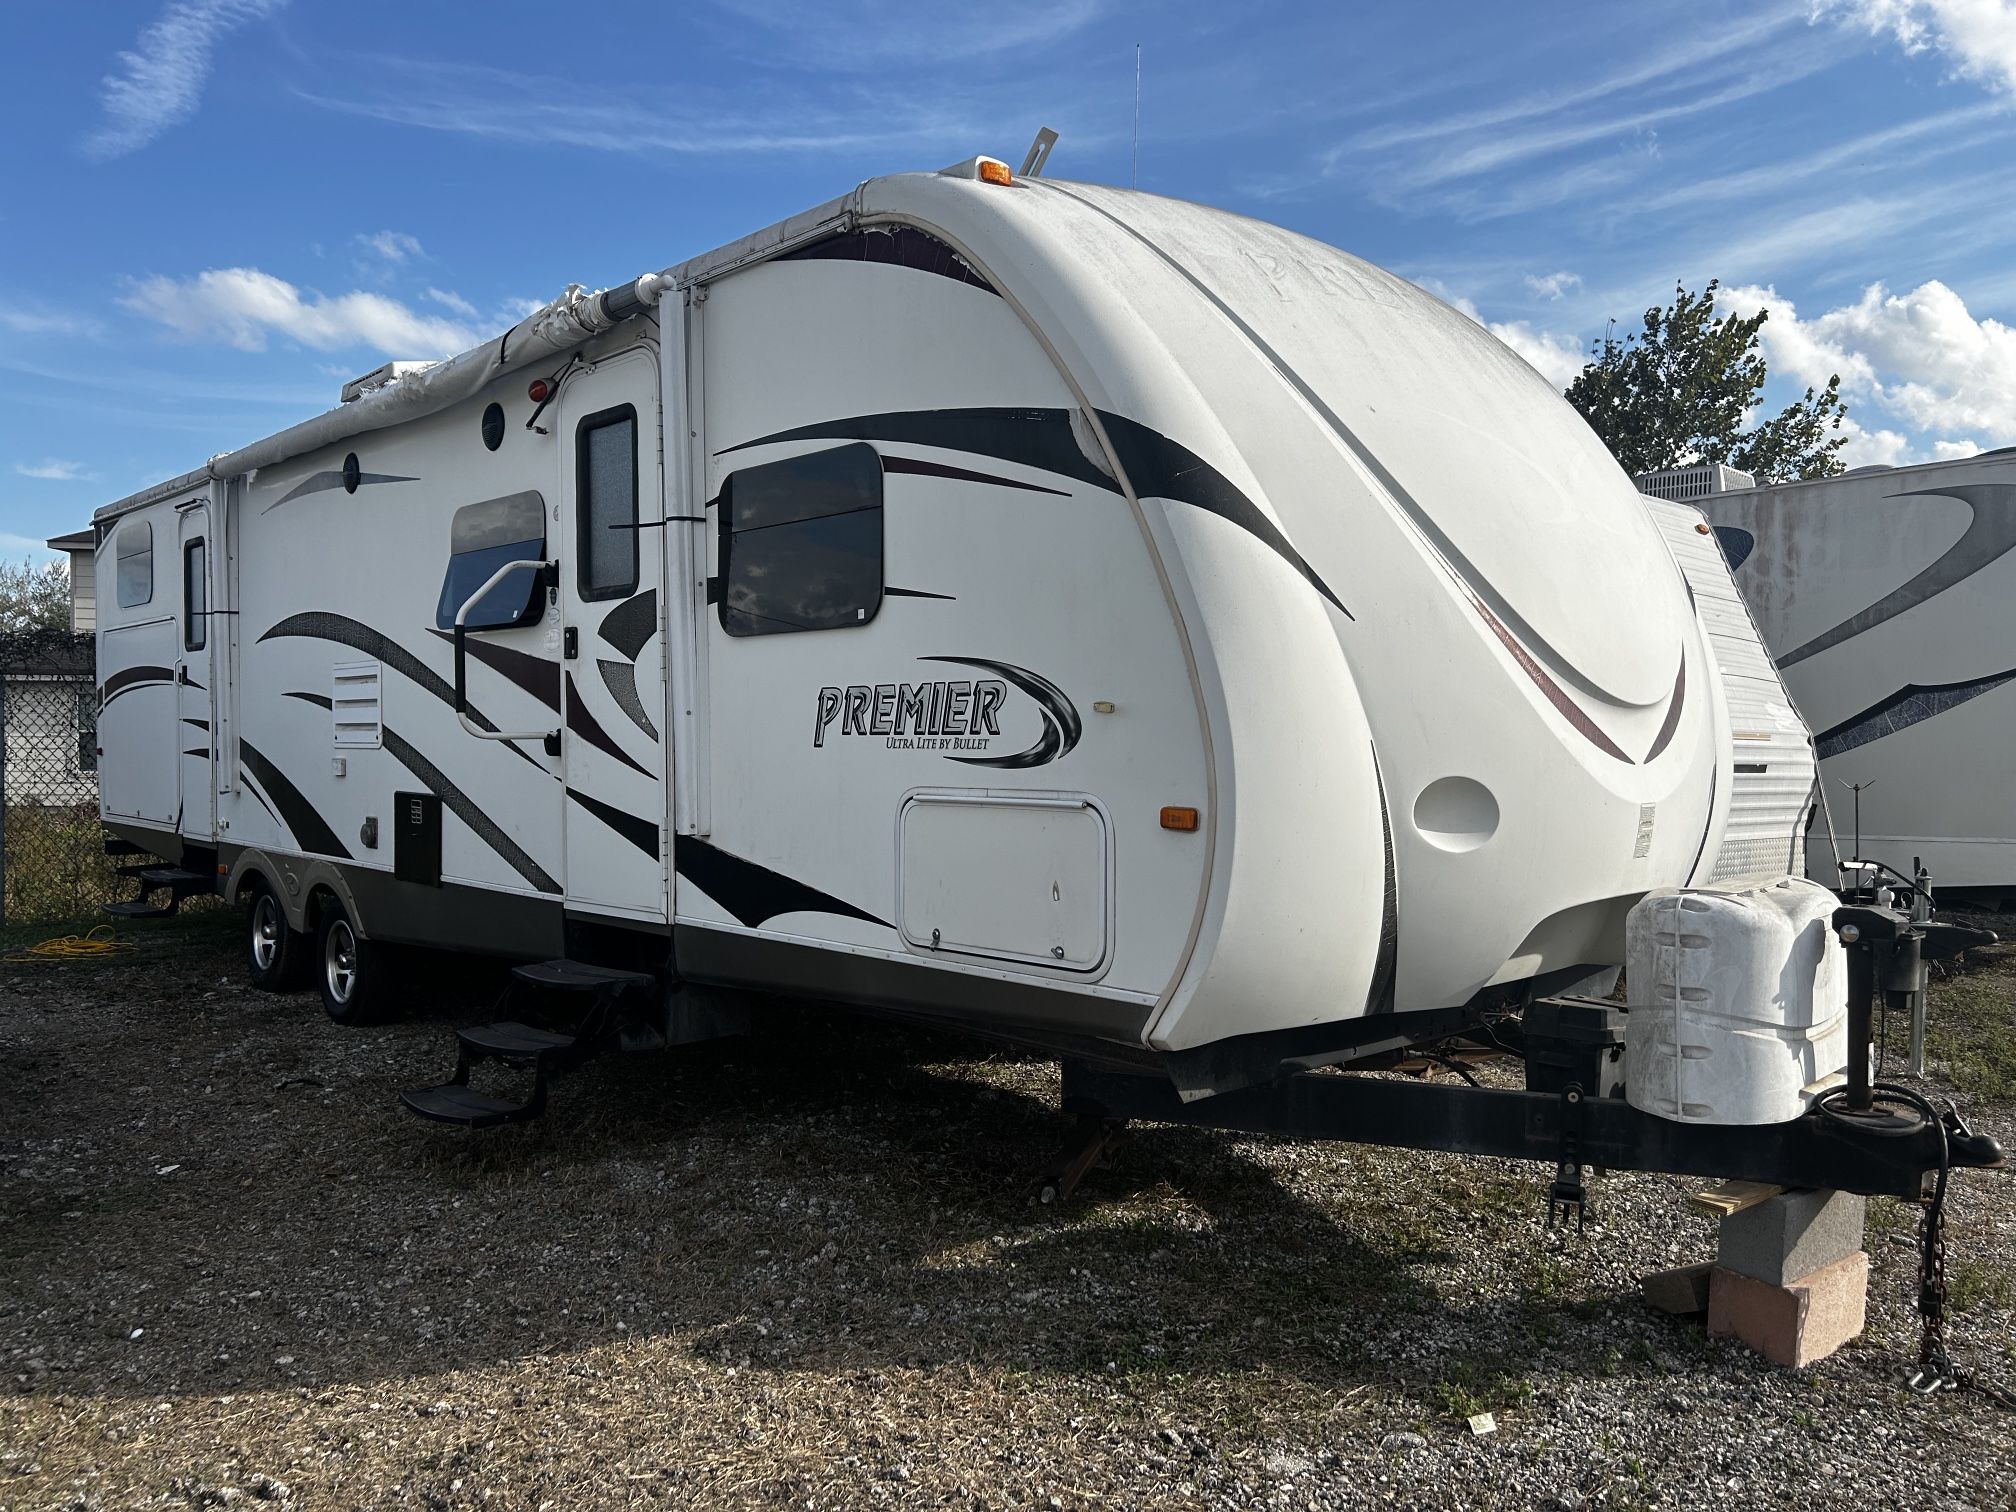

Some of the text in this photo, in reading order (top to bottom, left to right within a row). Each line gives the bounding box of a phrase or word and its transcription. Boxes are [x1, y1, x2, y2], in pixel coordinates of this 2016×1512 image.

[813, 679, 1007, 748] PREMIER
[886, 737, 914, 749] ULTRA
[916, 737, 938, 749] LITE
[953, 737, 990, 750] BULLET
